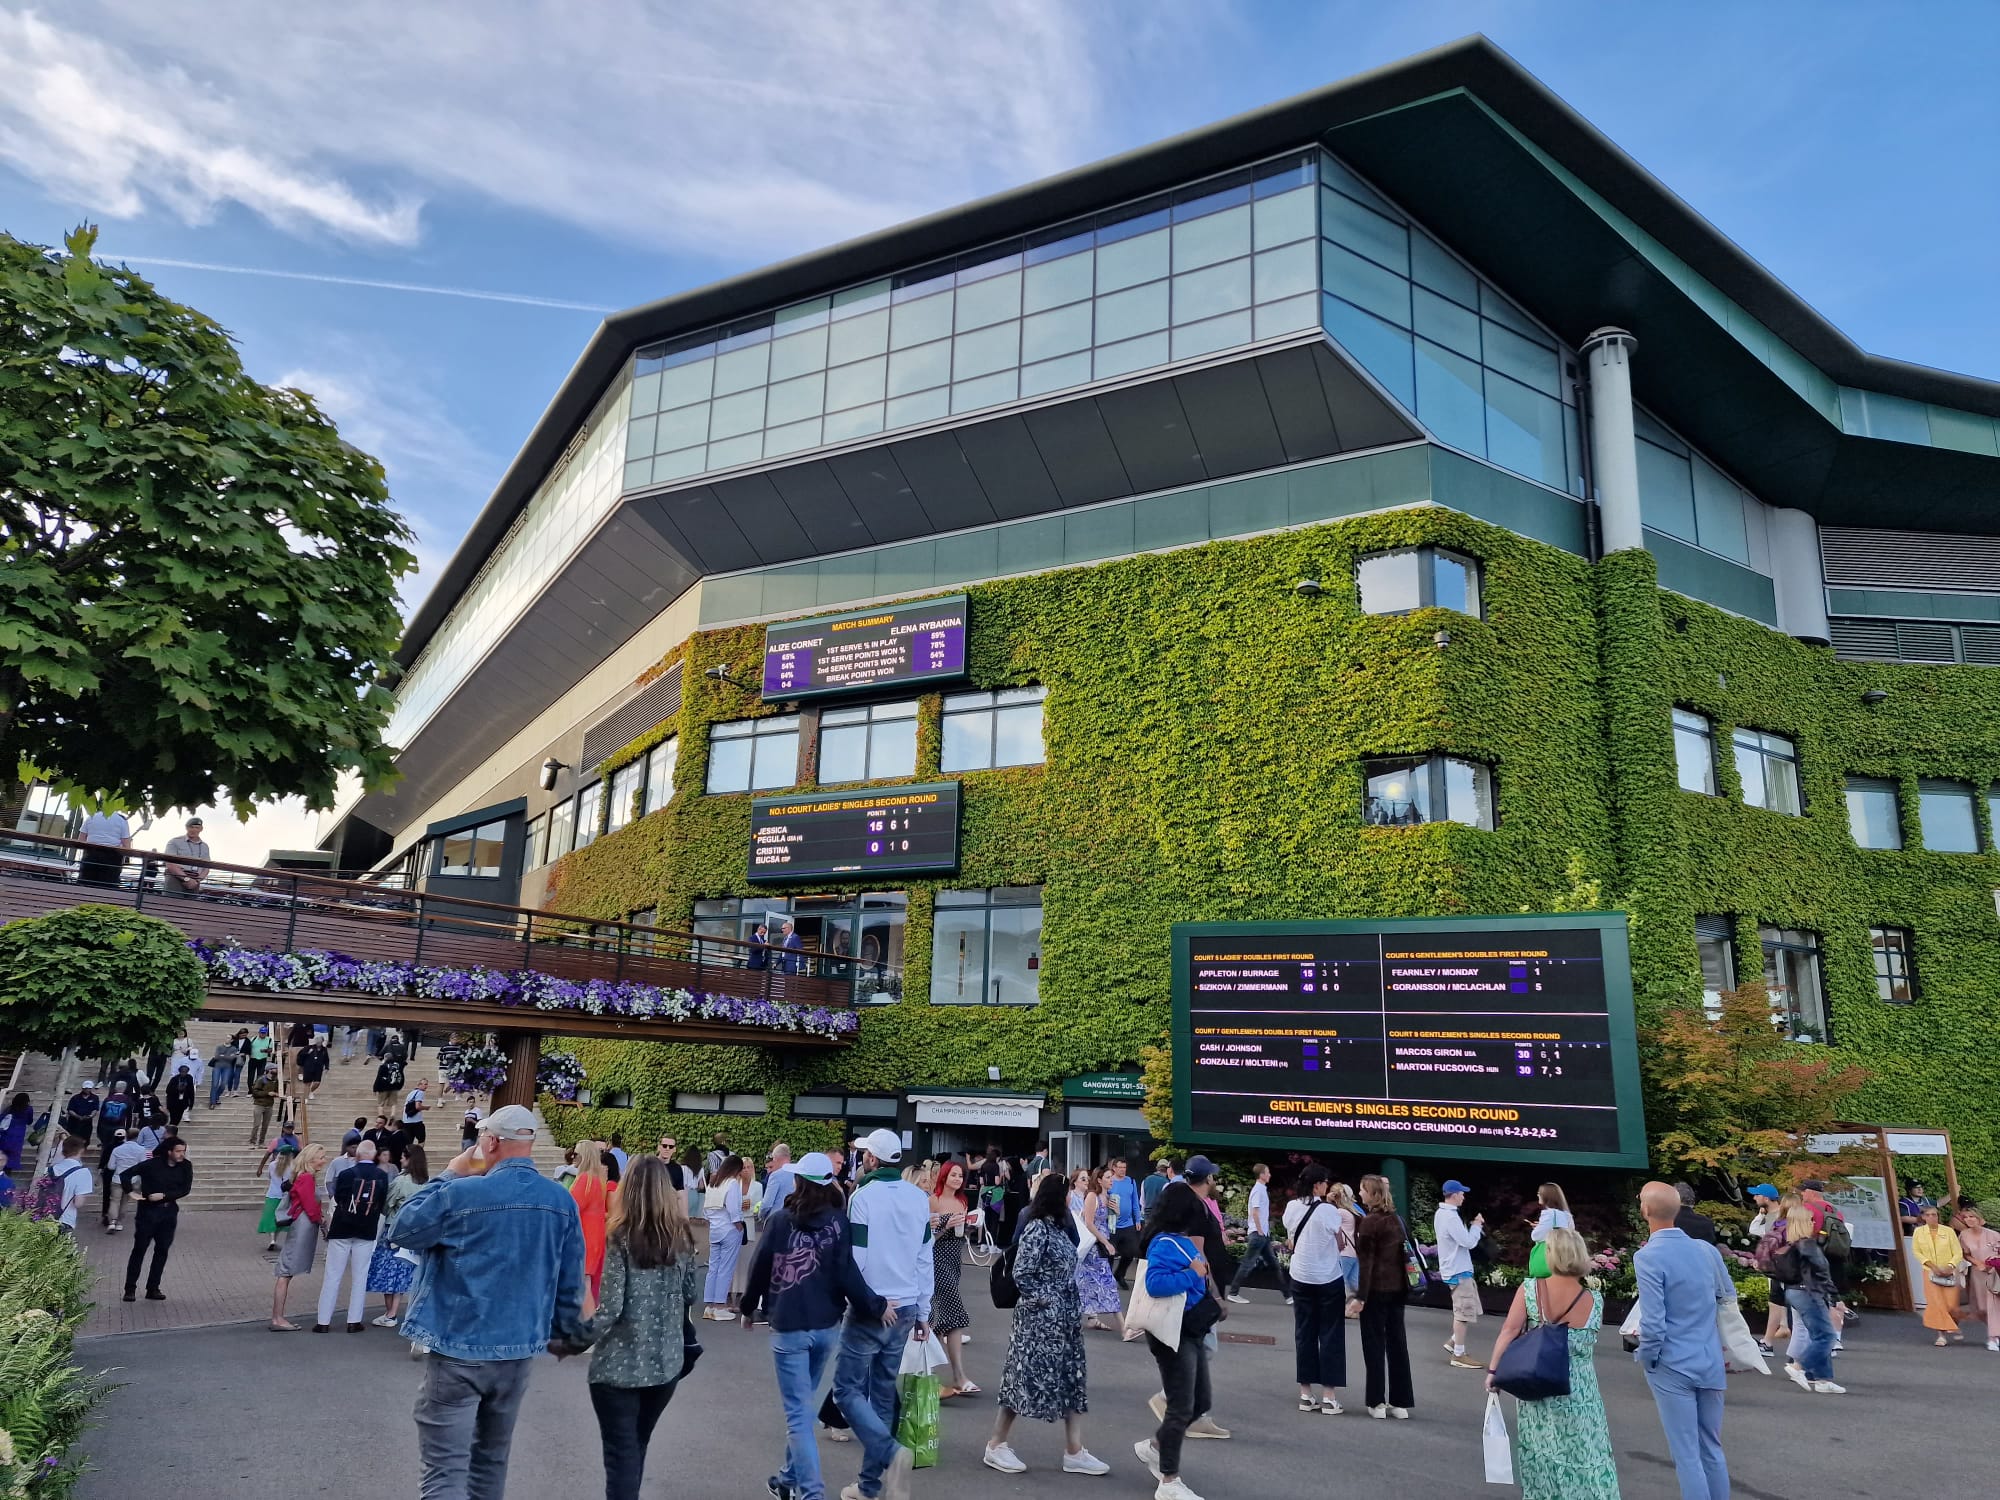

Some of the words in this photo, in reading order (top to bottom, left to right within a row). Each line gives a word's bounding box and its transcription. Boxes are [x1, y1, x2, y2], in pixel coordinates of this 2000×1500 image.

[832, 620, 856, 632] MATCH
[858, 616, 894, 628] SUMMARY
[890, 627, 918, 635] ELENA
[919, 618, 962, 631] RYBAKINA
[768, 642, 791, 653] ALIZE
[791, 638, 824, 650] CORNET
[827, 646, 839, 654] 1ST
[840, 643, 862, 652] SERVE
[880, 638, 897, 646] PLAY
[831, 654, 853, 664] SERVE
[854, 651, 879, 660] POINTS
[881, 648, 898, 656] WON
[830, 664, 853, 673] SERVE
[854, 661, 879, 669] POINTS
[880, 657, 897, 666] WON
[826, 673, 850, 682] BREAK
[850, 670, 876, 678] POINTS
[877, 667, 894, 675] WON
[769, 807, 786, 816] NO.1
[787, 804, 812, 814] COURT
[813, 802, 840, 812] LADIES'
[842, 800, 874, 809] SINGLES
[876, 797, 907, 806] SECOND
[908, 794, 937, 804] ROUND
[757, 835, 786, 844] PEGULA
[870, 821, 883, 831] 15
[890, 820, 896, 830] 6
[904, 819, 909, 829] 1
[758, 826, 787, 835] JESSICA
[755, 856, 780, 864] BUCSA
[871, 842, 878, 852] 0
[890, 841, 894, 851] 1
[902, 840, 909, 850] 0
[756, 846, 789, 855] CRISTINA
[1245, 1059, 1278, 1067] MOLTENI
[1517, 1051, 1530, 1059] 30
[1554, 1051, 1560, 1059] 1
[1396, 1063, 1433, 1071] MARTON
[1434, 1064, 1484, 1073] FUCSOVICS
[1519, 1066, 1531, 1075] 30
[1541, 1066, 1548, 1074] 7
[143, 1108, 151, 1117] 5
[1270, 1100, 1352, 1114] GENTLEMEN'S
[1355, 1104, 1408, 1116] SINGLES
[1412, 1106, 1467, 1119] SECOND
[1470, 1108, 1519, 1121] ROUND
[1240, 1115, 1256, 1124] JIRI
[1258, 1116, 1300, 1125] LEHECKA
[1315, 1118, 1353, 1128] Defeated
[1355, 1120, 1412, 1131] FRANCISCO
[1414, 1122, 1476, 1134] CERUNDOLO
